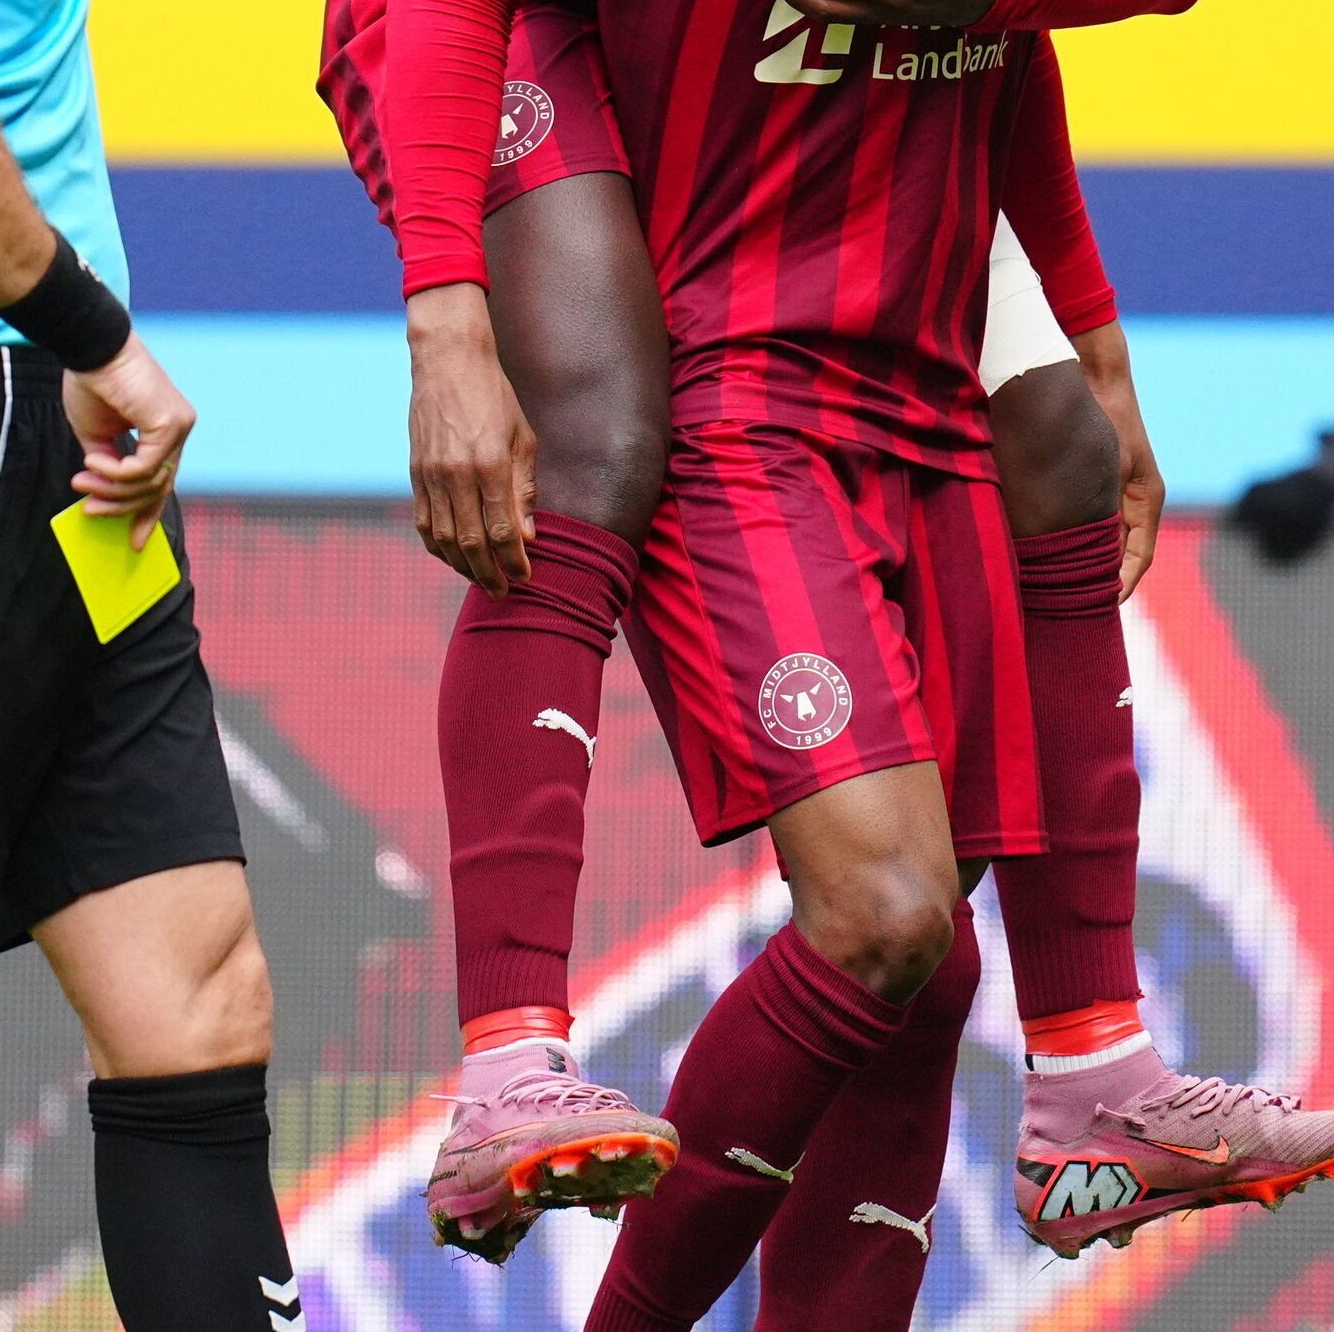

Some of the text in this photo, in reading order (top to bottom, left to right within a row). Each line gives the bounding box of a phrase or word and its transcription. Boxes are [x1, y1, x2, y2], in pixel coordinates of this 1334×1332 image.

[507, 84, 550, 120] YLLAND
[499, 139, 533, 162] 1999
[762, 656, 848, 730] FC MIDTJYLLAND
[795, 727, 833, 746] 1999
